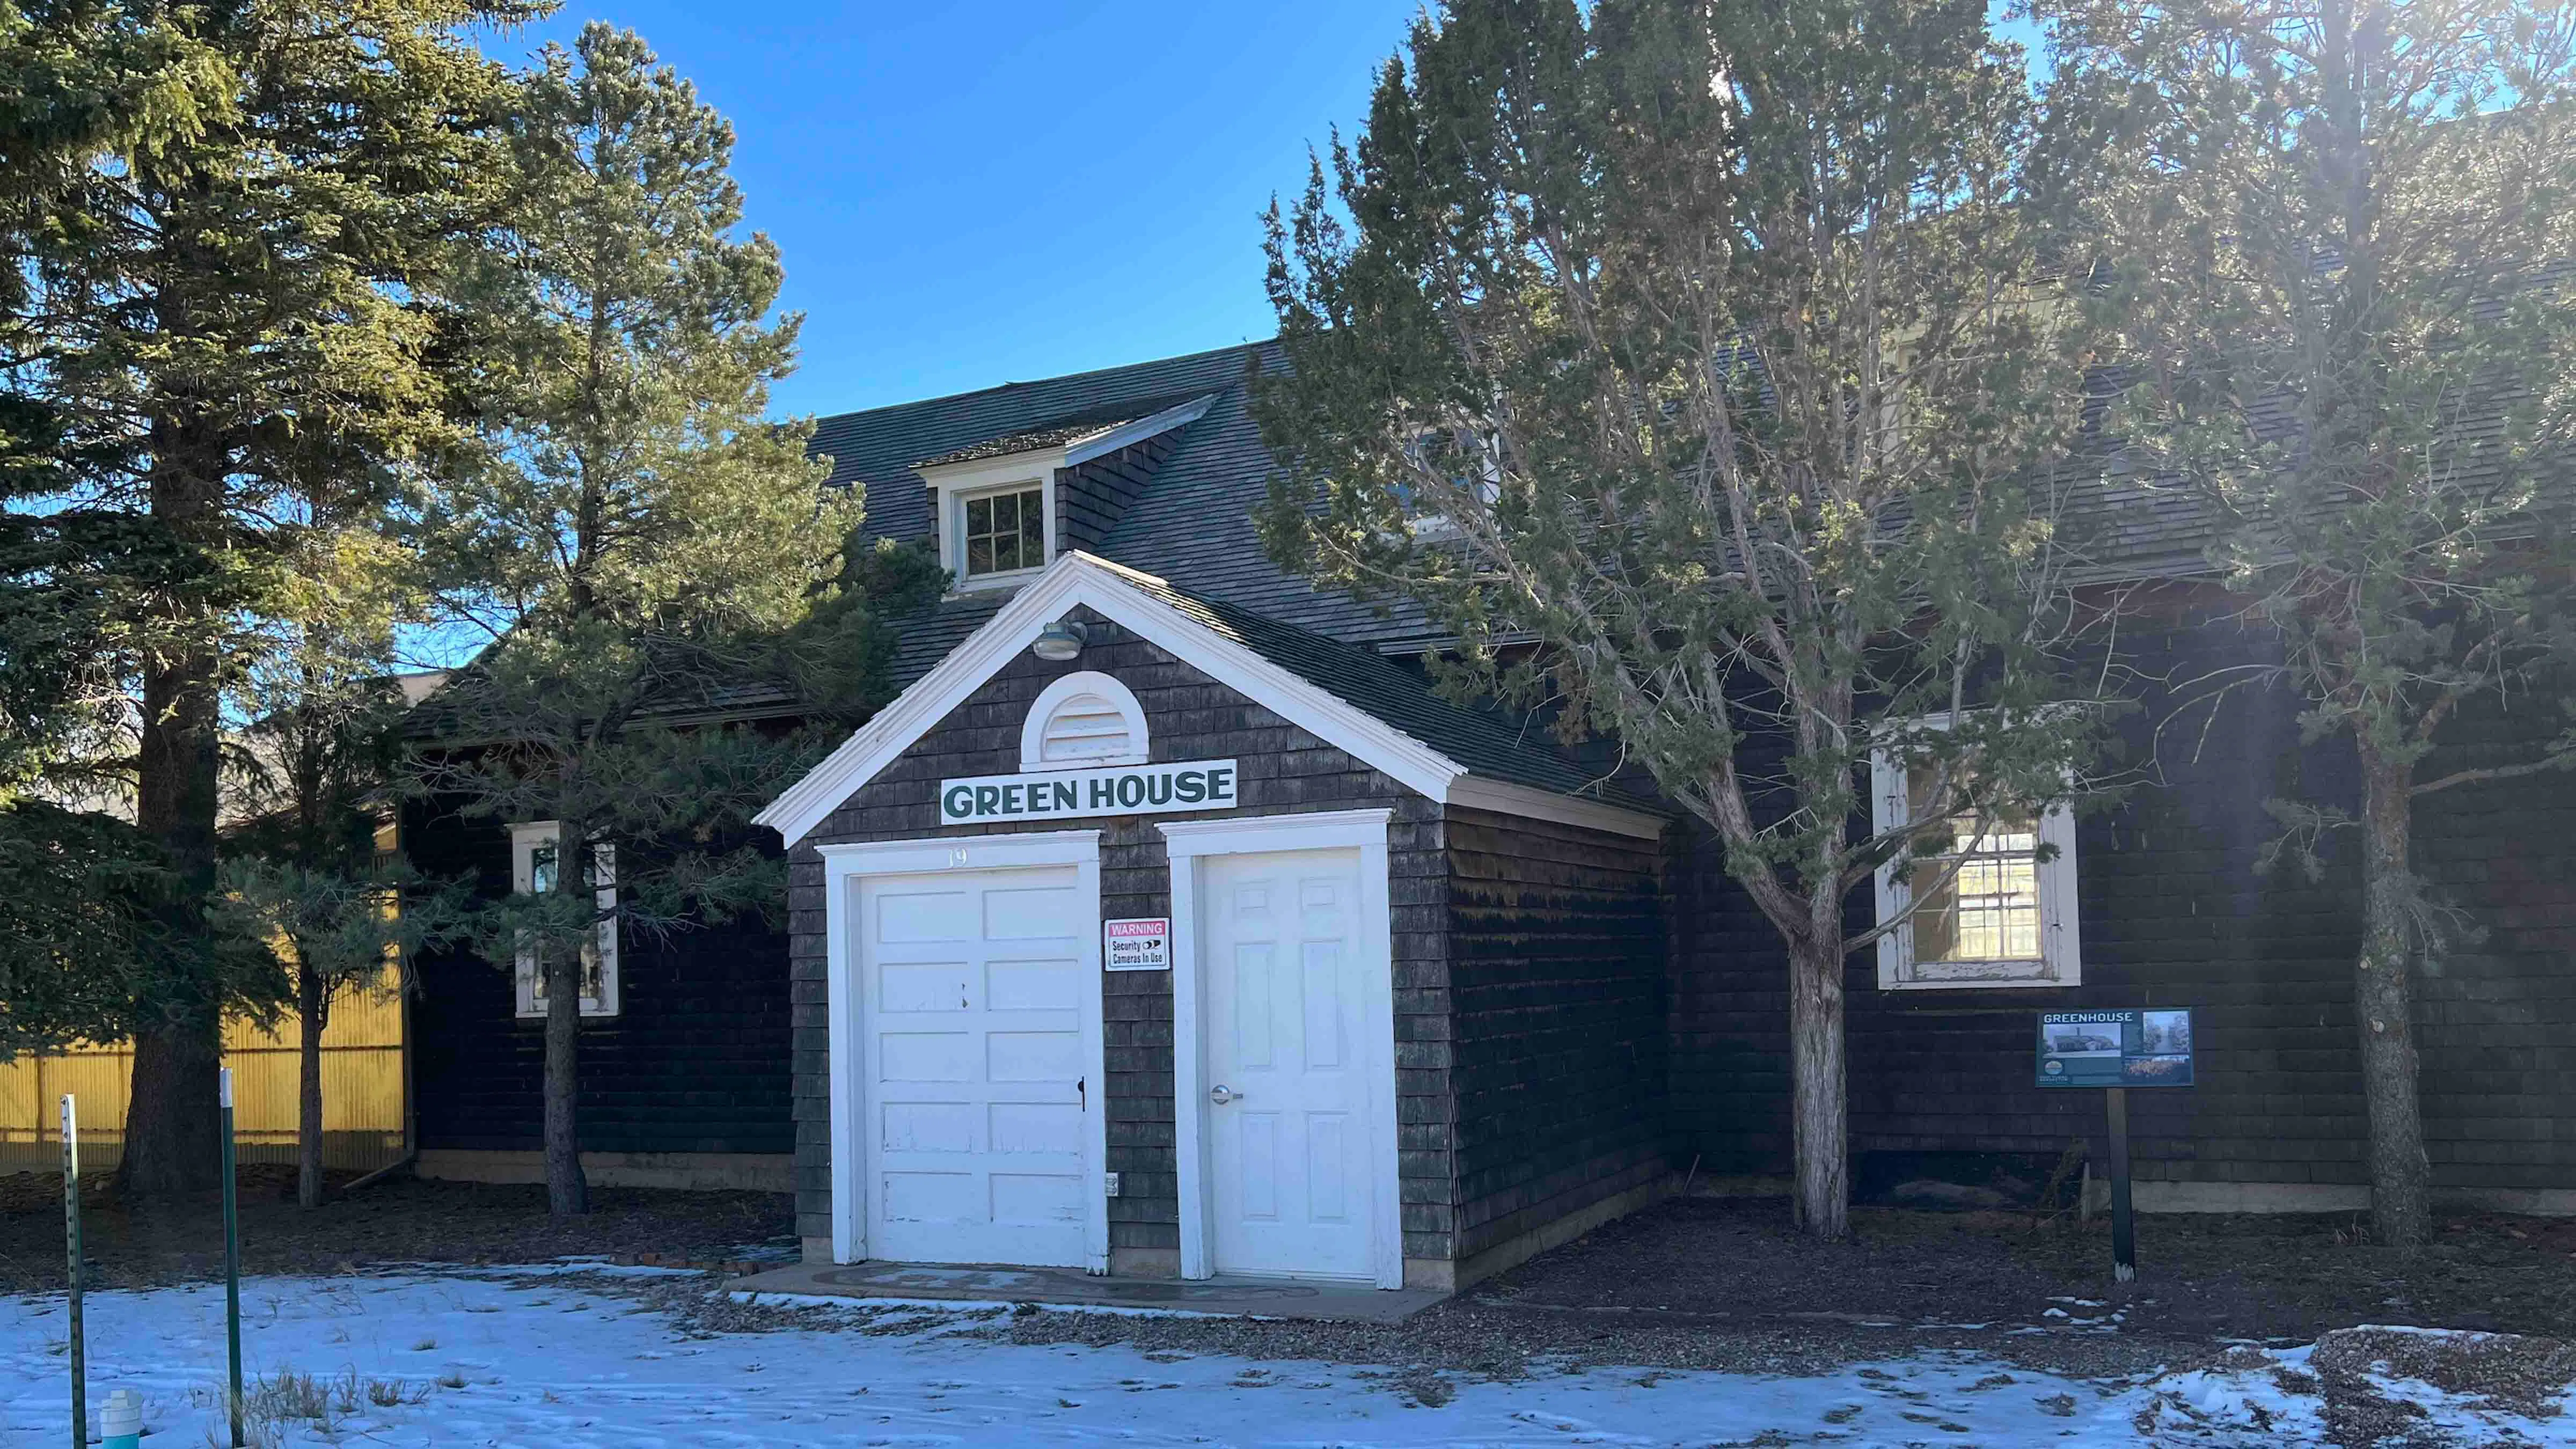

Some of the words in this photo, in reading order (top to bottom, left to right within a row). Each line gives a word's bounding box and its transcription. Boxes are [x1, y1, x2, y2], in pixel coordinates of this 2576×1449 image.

[943, 780, 1077, 818] GREEN
[1089, 769, 1233, 808] HOUSE
[948, 846, 967, 867] 19
[1111, 923, 1162, 935] WARNING
[1113, 940, 1141, 952] Security
[1113, 953, 1141, 964] Cameras
[1143, 953, 1149, 963] In
[1151, 952, 1162, 963] Use
[2044, 1013, 2133, 1023] GREENHOUSE
